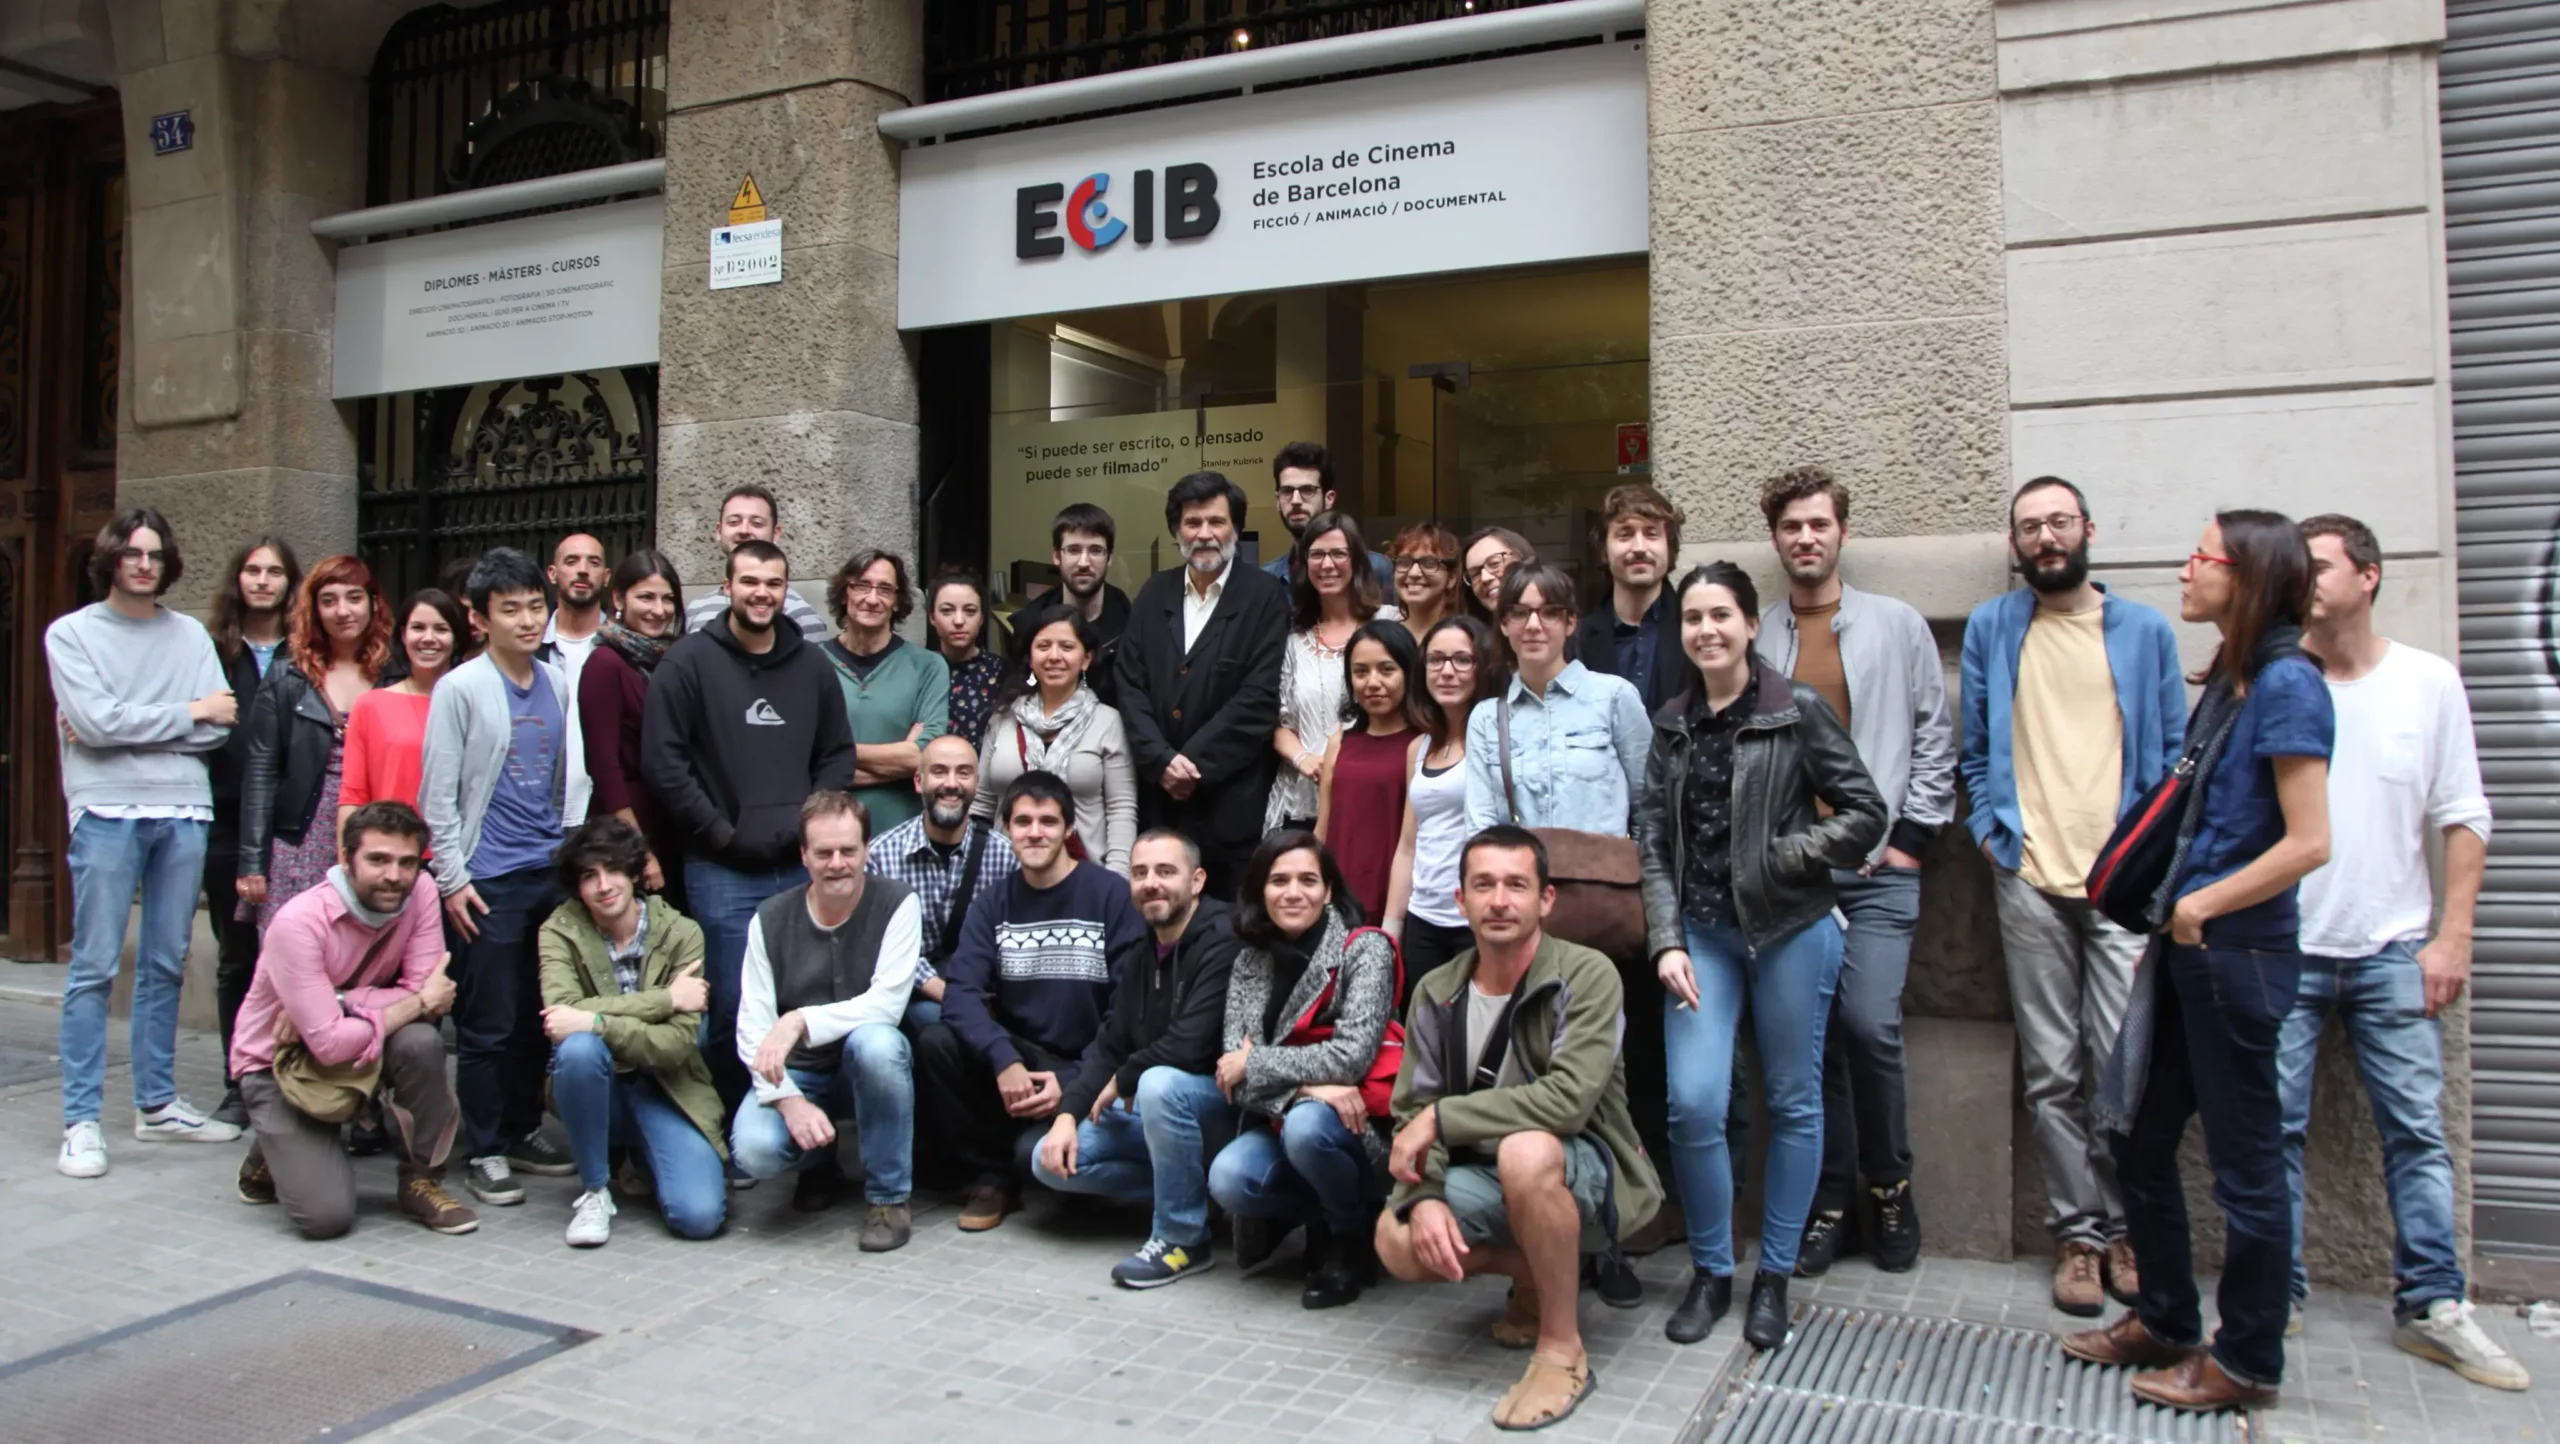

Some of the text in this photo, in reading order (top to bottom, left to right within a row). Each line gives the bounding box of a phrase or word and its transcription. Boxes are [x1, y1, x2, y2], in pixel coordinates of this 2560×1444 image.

[156, 116, 183, 149] 54
[1253, 140, 1455, 180] Escola de Cinema
[1252, 175, 1401, 207] de Barcelona
[1015, 161, 1222, 260] ECIB
[1253, 190, 1507, 230] FICCIÓ ANIMACIÓ DOCUMENTAL
[424, 255, 600, 292] DIPLOMES MÀSTERS CURSOS
[447, 311, 490, 323] DOCUMENTAL
[511, 306, 524, 314] PER
[531, 302, 556, 312] CINEMA
[561, 300, 570, 308] TV
[501, 290, 541, 302] FOTOGRAFIA
[1042, 443, 1088, 461] puede
[1093, 440, 1115, 455] ser
[1119, 435, 1175, 452] escrito,
[1179, 435, 1190, 448] o
[1195, 429, 1264, 449] pensado
[1233, 456, 1264, 466] Kubrick
[1026, 457, 1168, 484] puede ser filmado”
